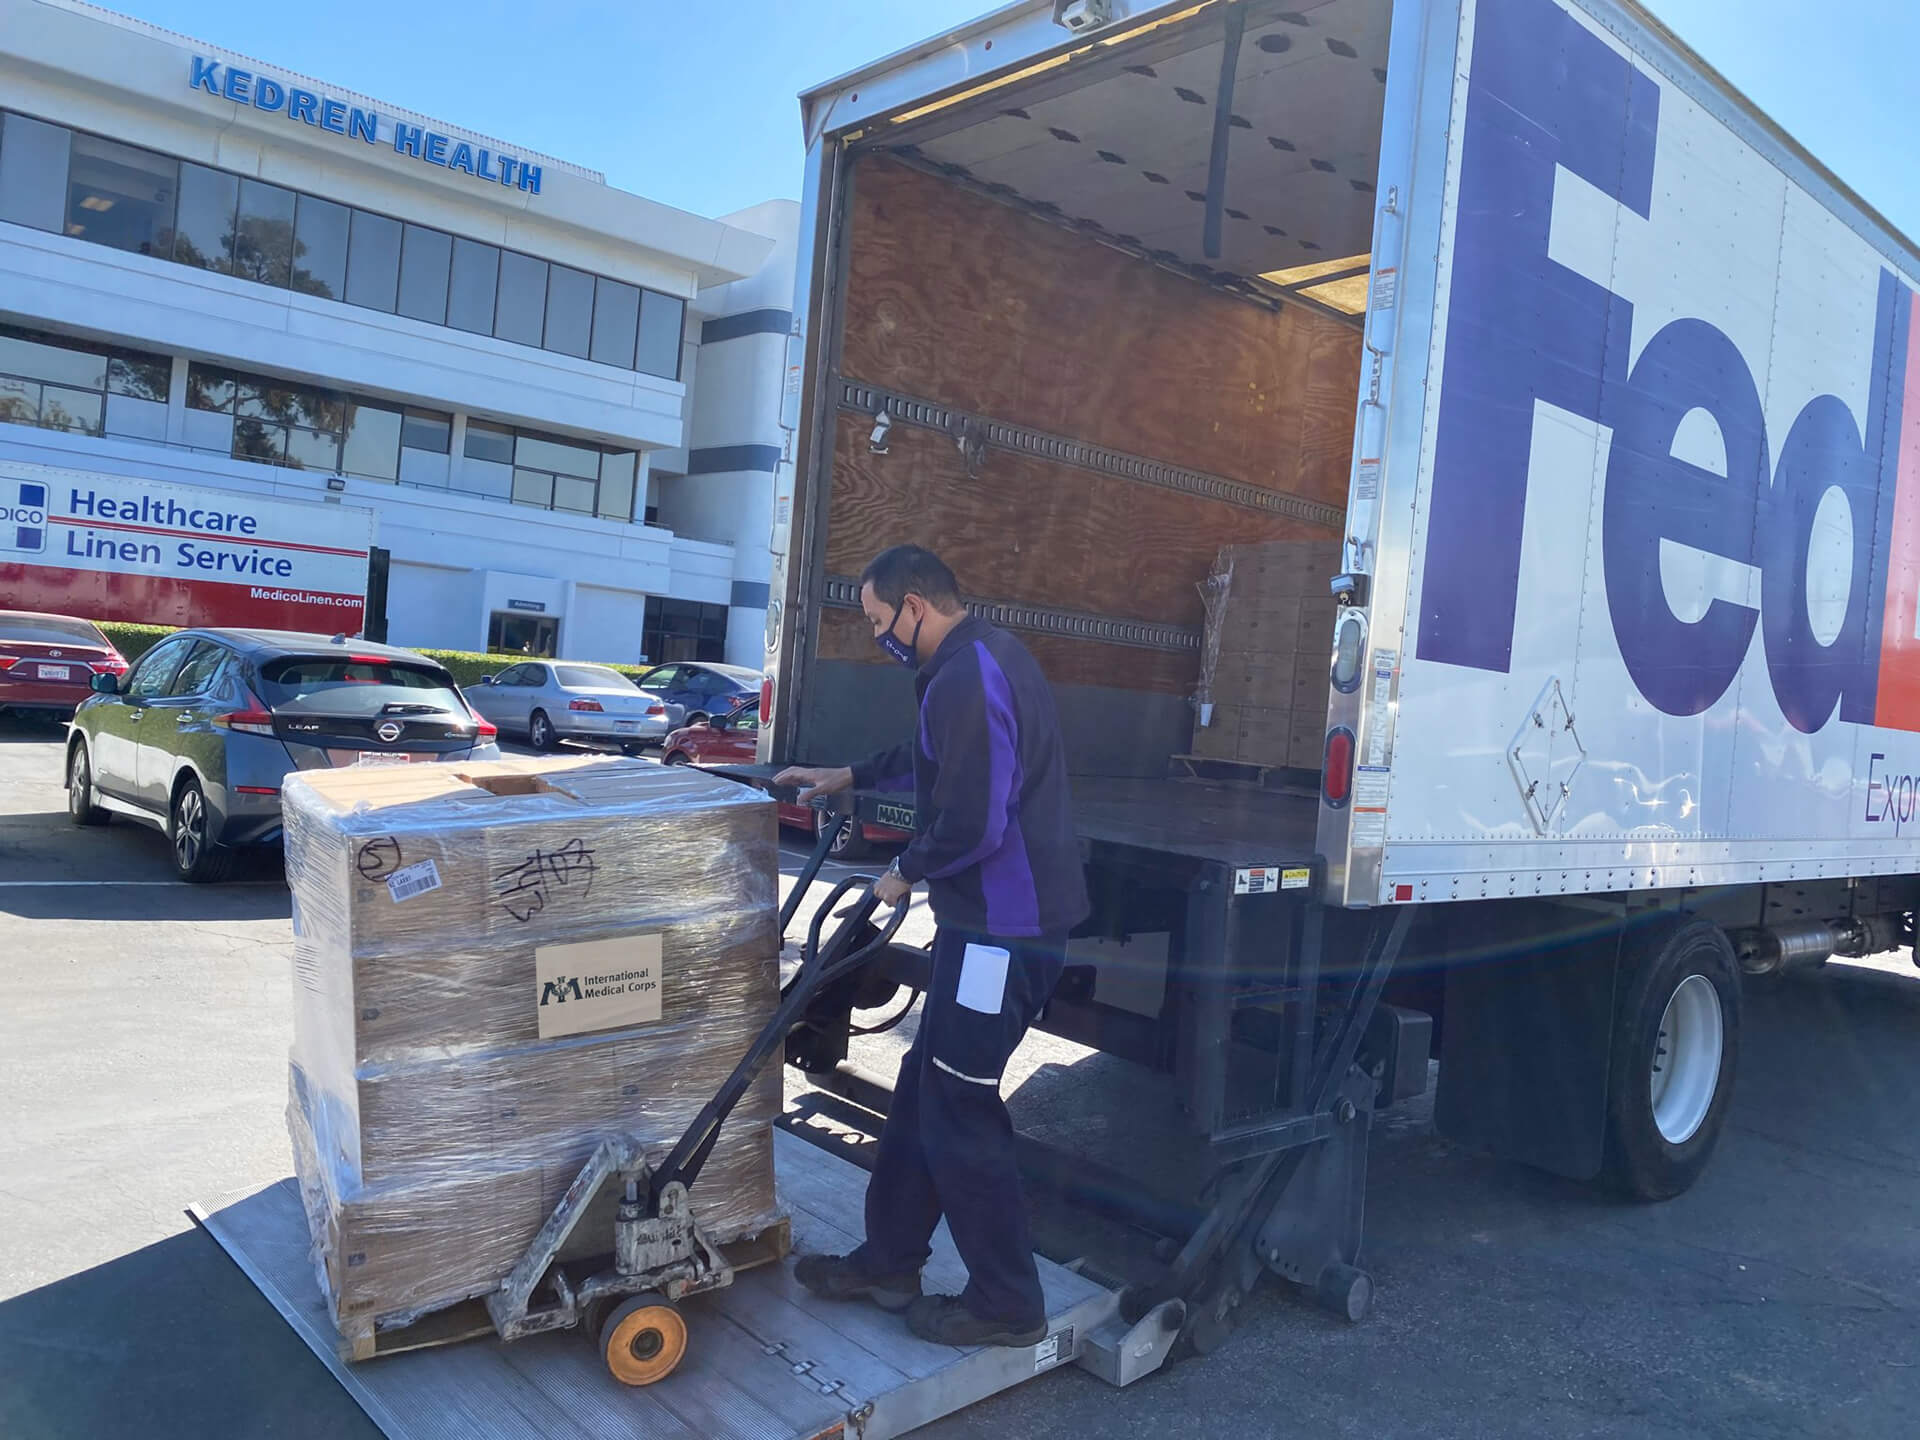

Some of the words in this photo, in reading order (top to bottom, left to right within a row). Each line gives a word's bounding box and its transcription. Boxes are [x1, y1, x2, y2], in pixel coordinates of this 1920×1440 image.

[190, 56, 377, 144] KEDREN
[395, 123, 542, 194] HEALTH
[70, 489, 257, 534] Healthcare
[66, 530, 161, 565] Linen
[176, 542, 293, 578] Service
[250, 587, 362, 608] MedicoLinen.com
[288, 723, 320, 731] LEAF
[584, 967, 649, 986] International
[584, 984, 625, 999] Medical
[628, 980, 657, 993] Corps
